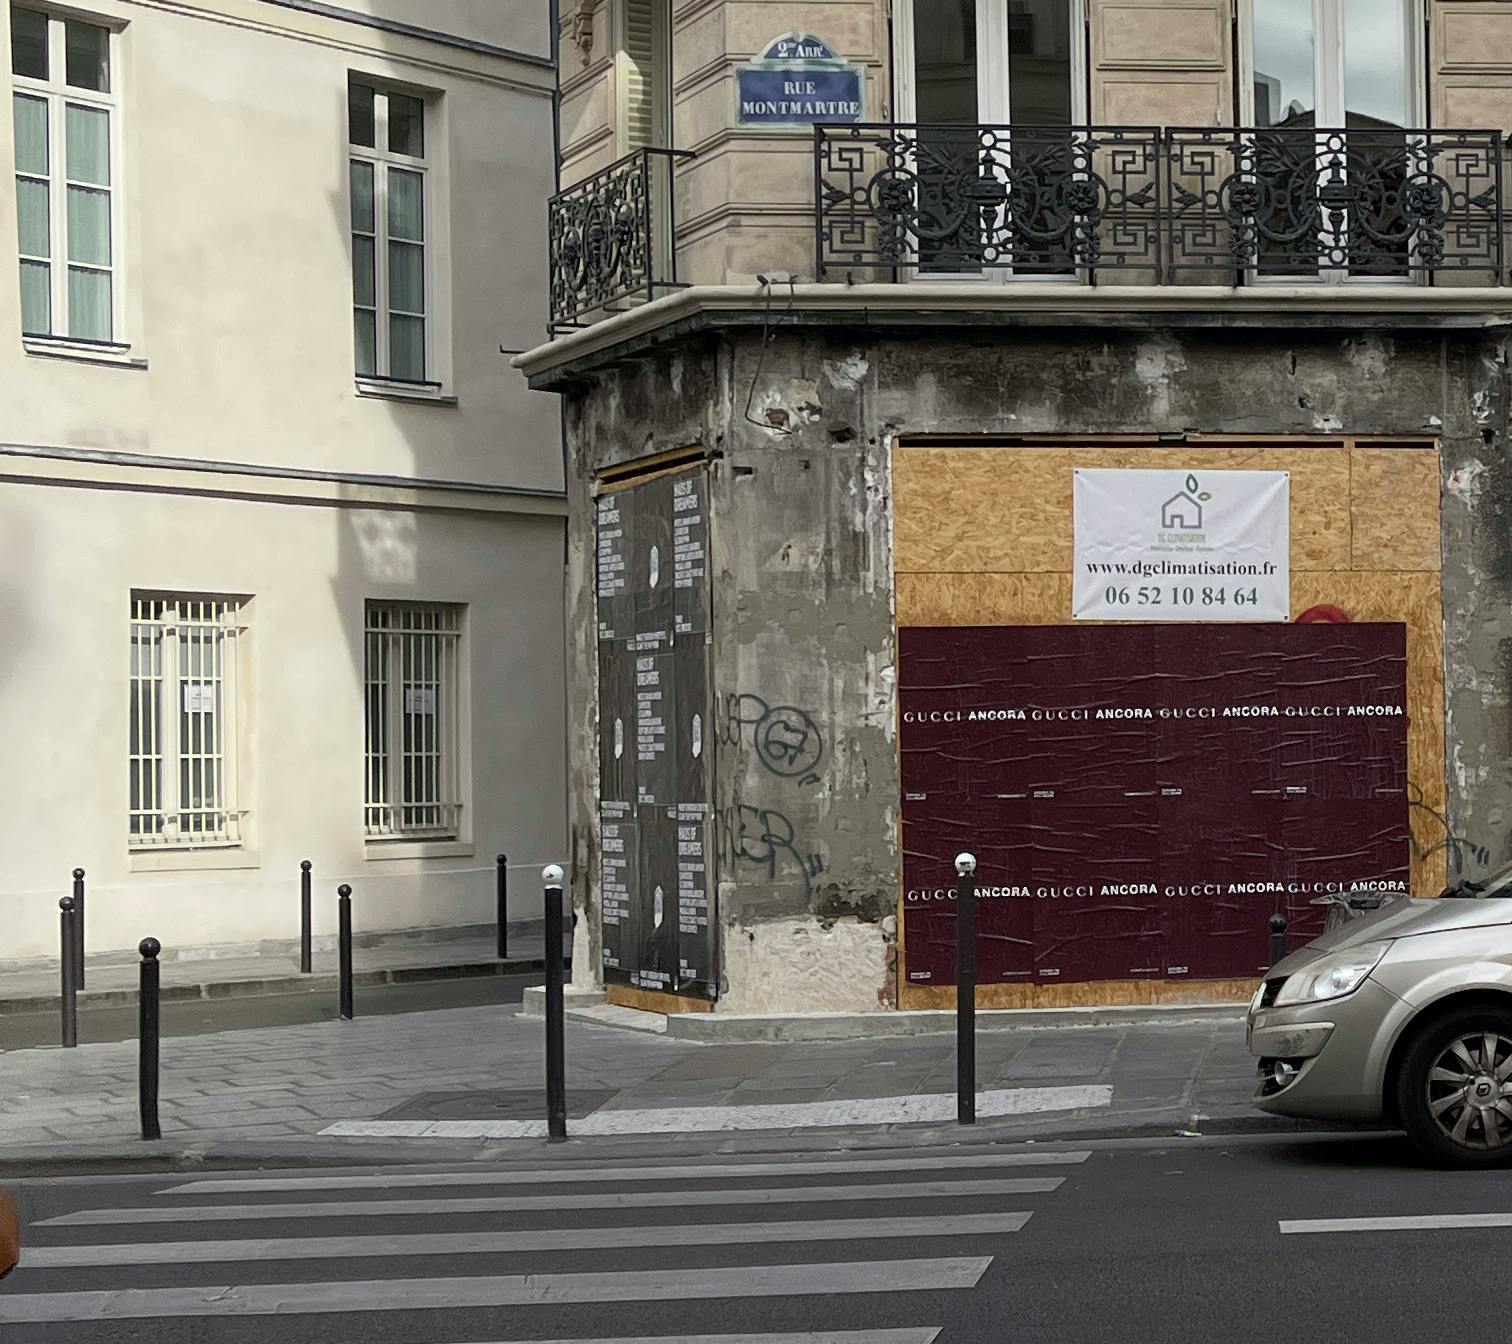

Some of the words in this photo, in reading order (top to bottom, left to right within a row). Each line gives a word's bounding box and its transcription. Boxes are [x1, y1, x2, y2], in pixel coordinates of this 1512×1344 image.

[784, 81, 816, 95] RUE
[742, 101, 860, 115] MONTMARTRE
[1086, 560, 1278, 577] www.dgclimatisation.fr
[1105, 586, 1130, 605] 06
[1138, 586, 1162, 605] 52
[1172, 586, 1195, 605] 10
[1202, 586, 1227, 605] 84
[1233, 586, 1258, 605] 64
[903, 710, 961, 723] GUCCI
[967, 709, 1027, 722] ANCORA
[1031, 709, 1089, 722] GUCCI
[1095, 708, 1153, 720] ANCORA
[1159, 707, 1216, 720] GUCCI
[1222, 705, 1279, 718] ANCORA
[1346, 705, 1403, 717] ANCORA
[907, 888, 958, 902] GUCC
[973, 886, 1031, 899] ANCORA
[1036, 885, 1094, 899] GUCCI
[1100, 883, 1158, 896] ANCORA
[1164, 883, 1221, 897] GUCCI
[1227, 881, 1285, 894] ANCORA
[1350, 880, 1406, 892] ANCORA
